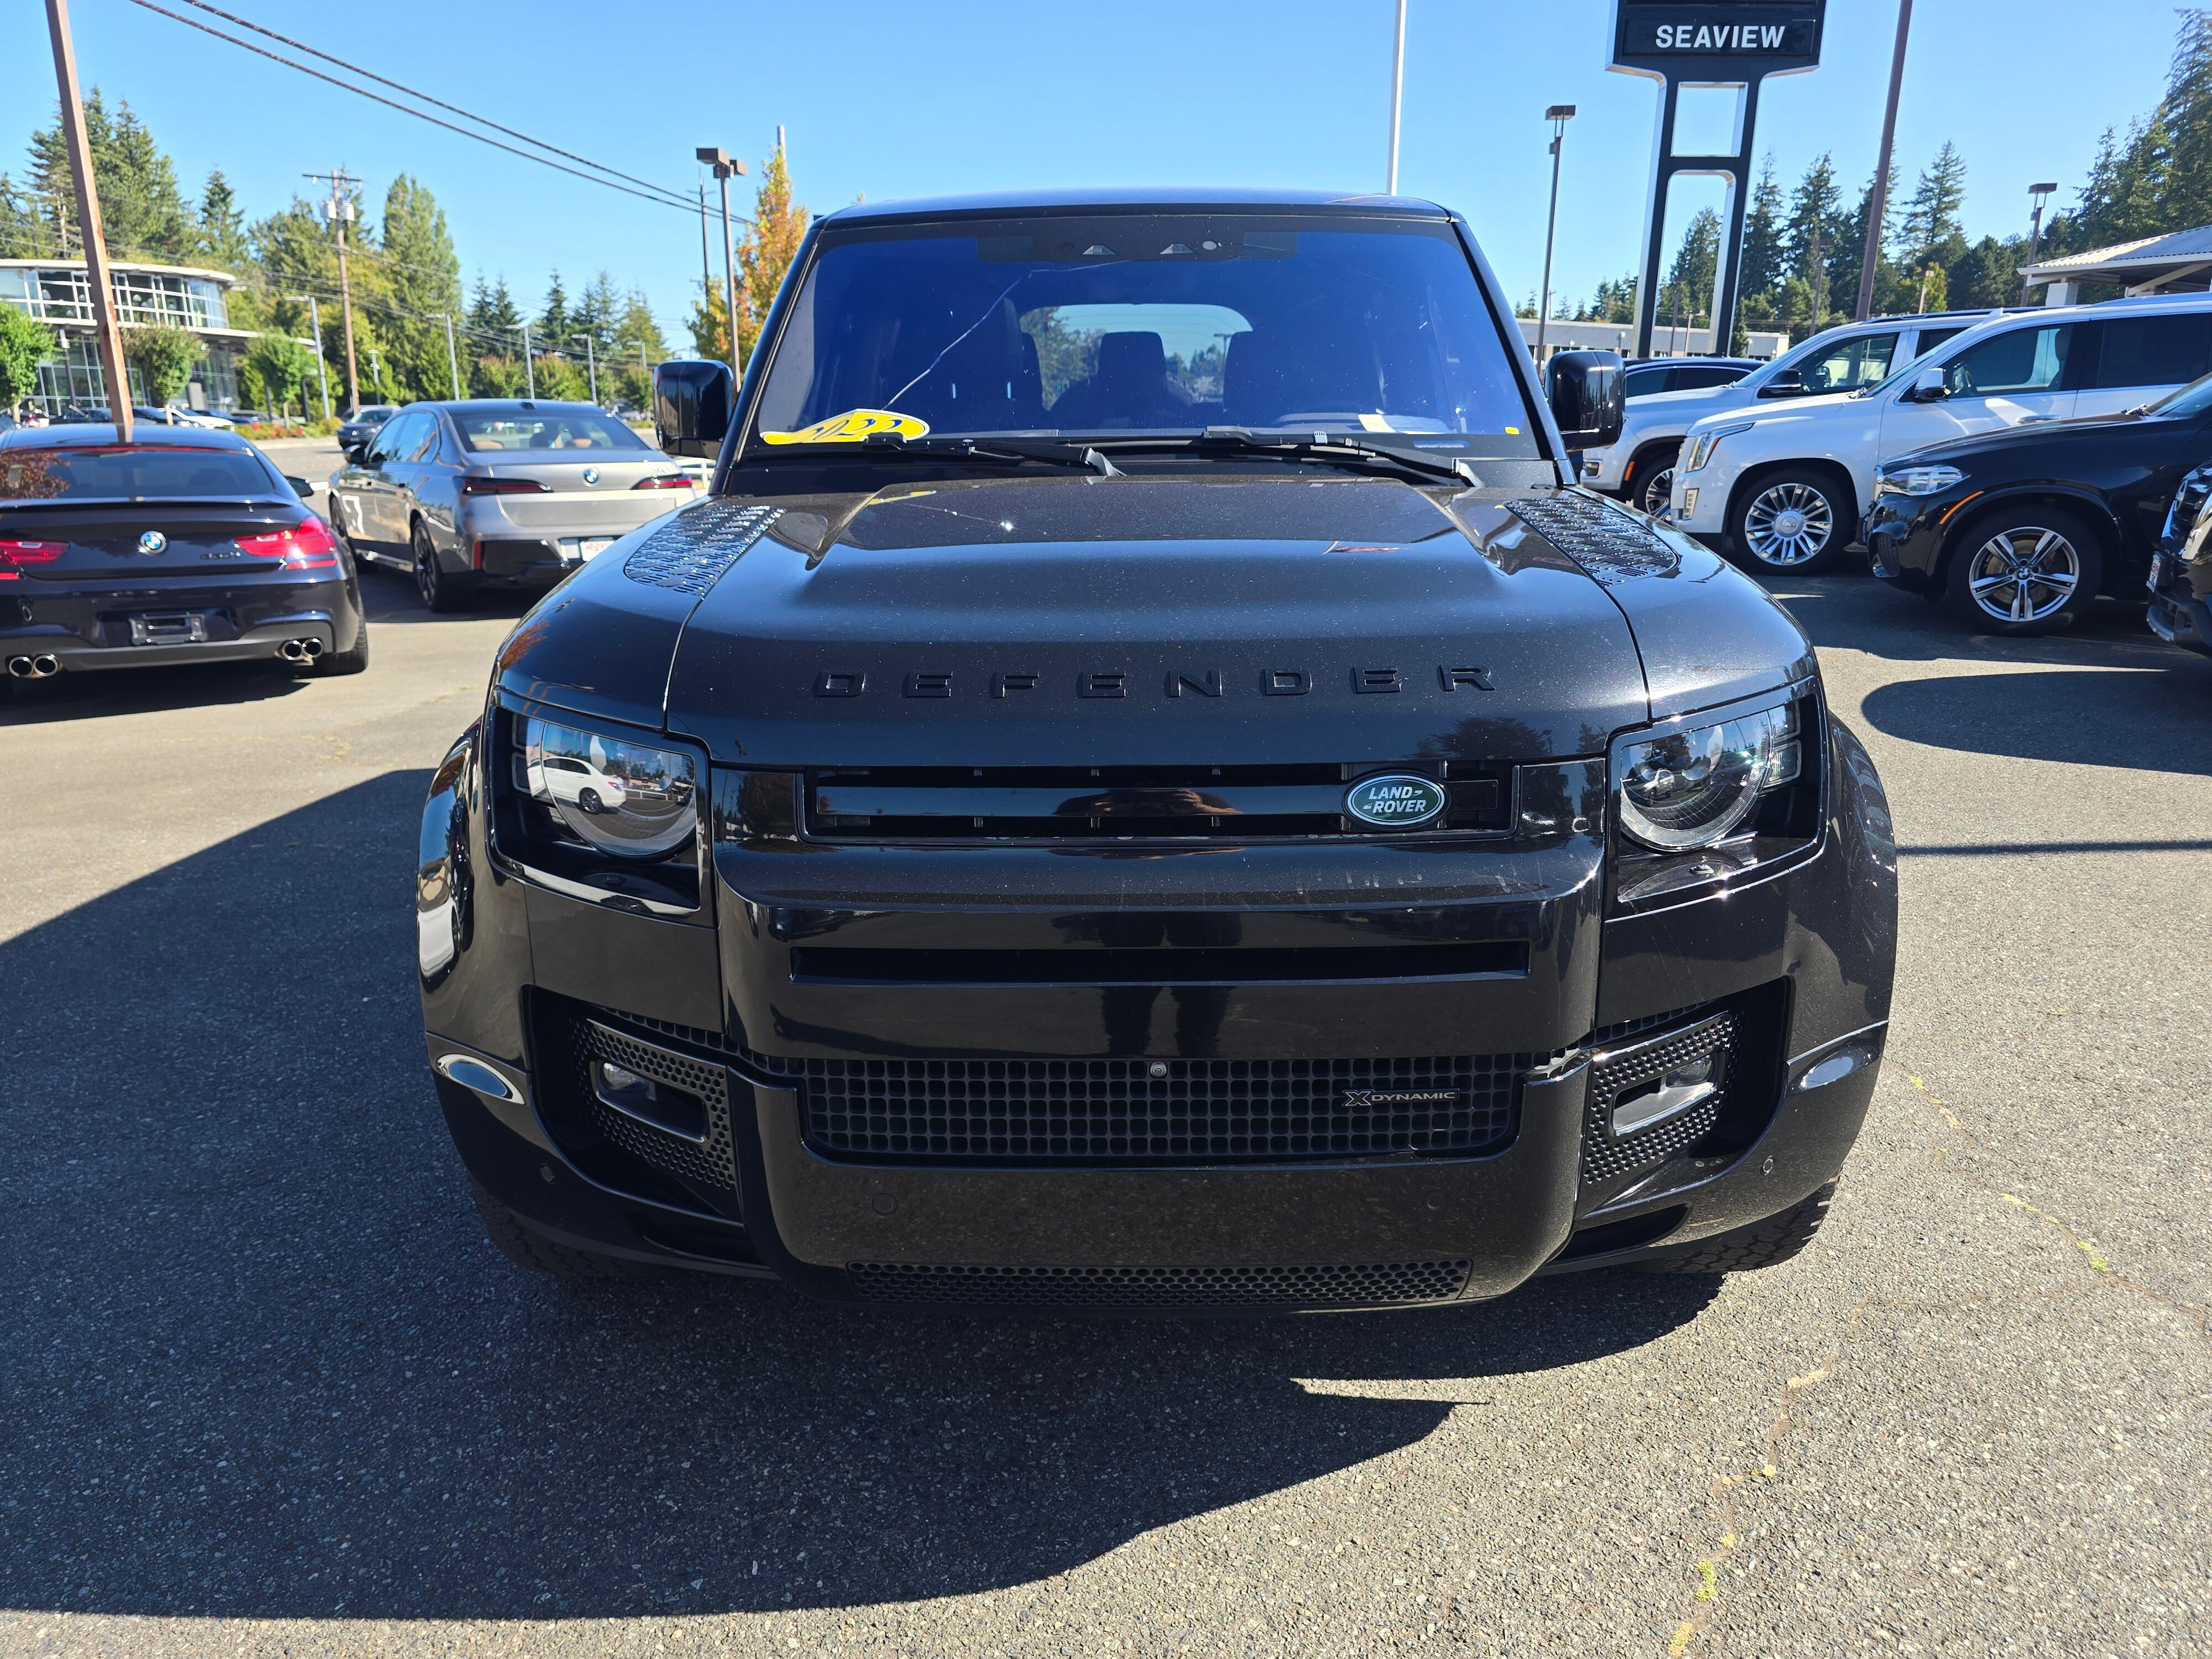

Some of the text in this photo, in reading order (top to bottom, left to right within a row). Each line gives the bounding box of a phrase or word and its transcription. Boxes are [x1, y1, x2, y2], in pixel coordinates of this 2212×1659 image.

[1655, 24, 1786, 49] SEAVIEW
[815, 663, 1496, 698] DEFENDER
[1368, 786, 1413, 800] LAND
[1371, 800, 1427, 813] ROVER
